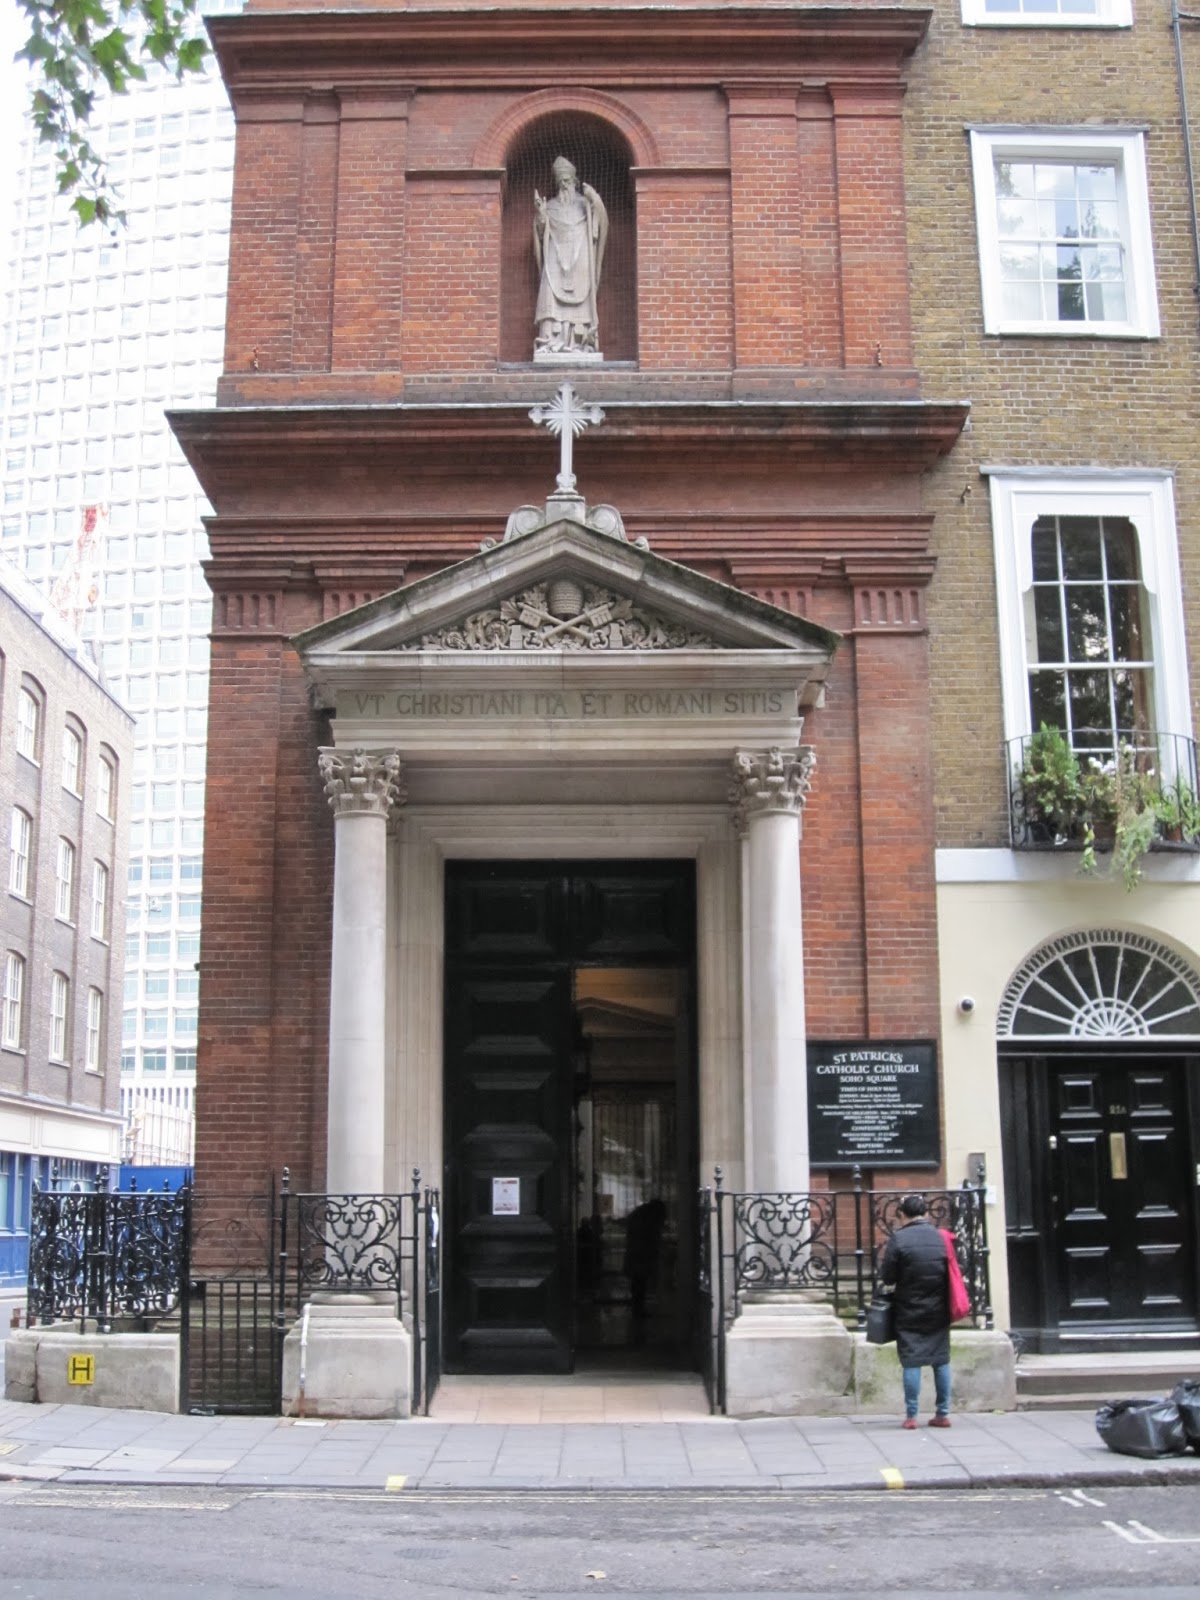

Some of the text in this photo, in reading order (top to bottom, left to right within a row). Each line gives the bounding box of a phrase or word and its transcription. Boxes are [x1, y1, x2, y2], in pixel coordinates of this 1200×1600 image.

[396, 693, 522, 715] CHRISTIANI
[534, 693, 568, 715] ITA
[580, 692, 612, 715] ET
[623, 692, 712, 715] ROMANI
[724, 692, 783, 713] SITIS
[833, 1053, 847, 1065] ST
[816, 1064, 919, 1075] CATHOLIC CHURCH
[840, 1075, 898, 1084] SOHO SQUARE
[72, 1357, 90, 1381] H
